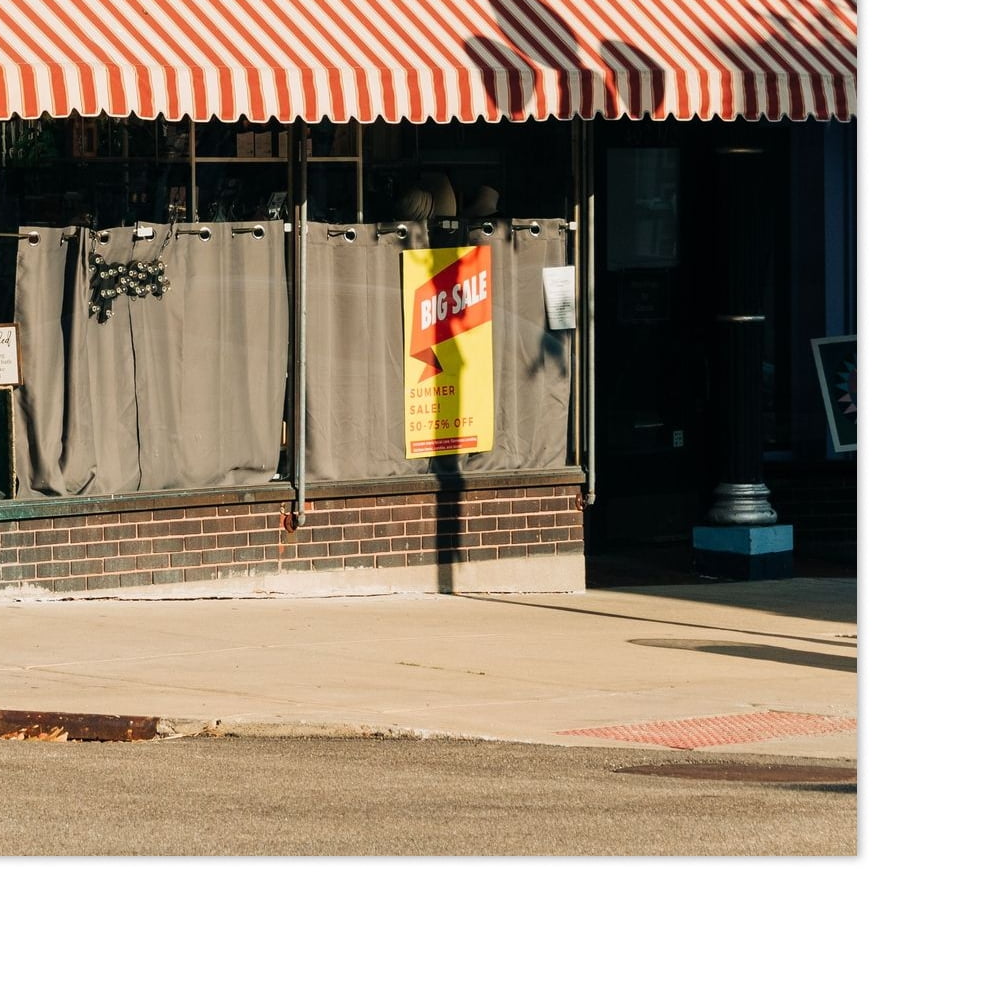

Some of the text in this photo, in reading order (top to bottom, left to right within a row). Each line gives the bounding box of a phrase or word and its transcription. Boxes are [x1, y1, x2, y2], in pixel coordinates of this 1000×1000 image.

[420, 270, 488, 331] BIG SALE
[409, 386, 456, 399] SUMMER
[409, 402, 441, 415] SALE!
[409, 416, 474, 432] 50-75% OFF
